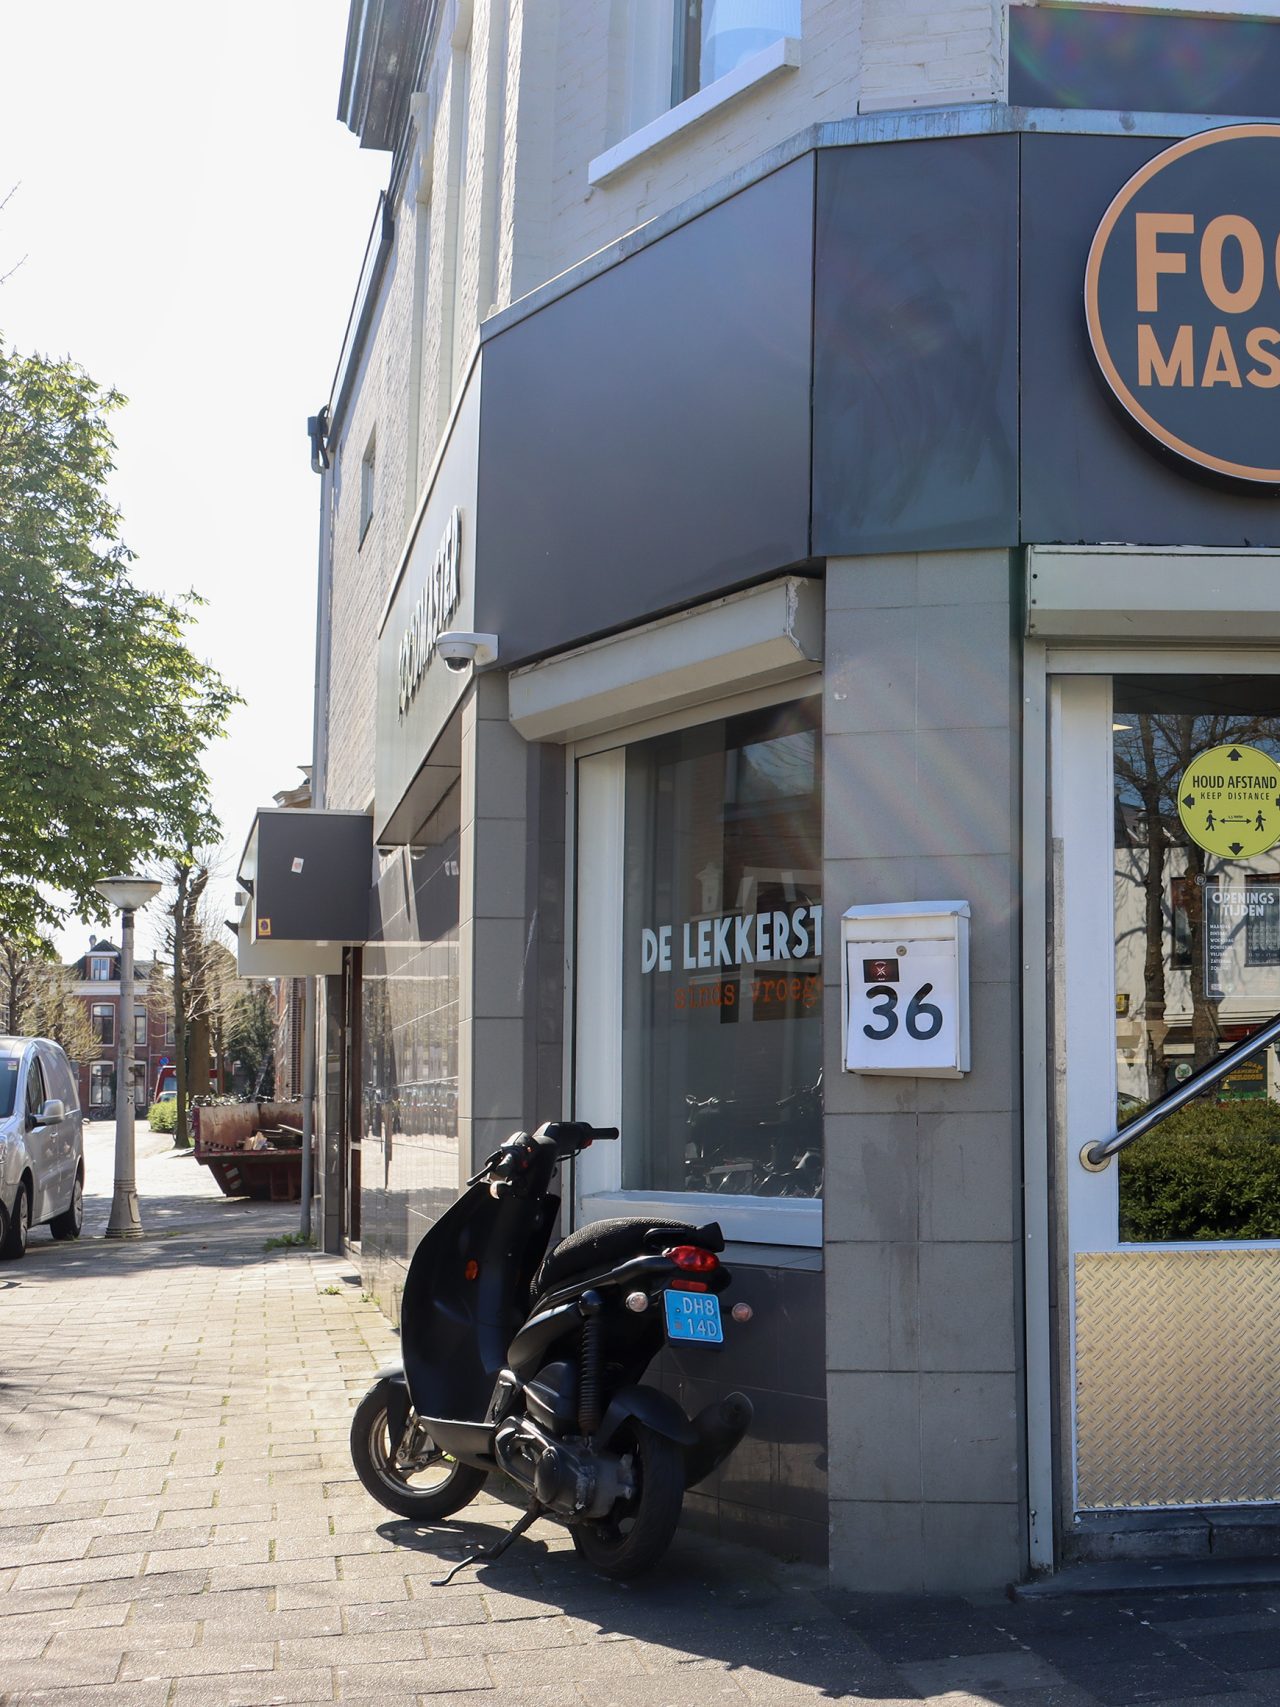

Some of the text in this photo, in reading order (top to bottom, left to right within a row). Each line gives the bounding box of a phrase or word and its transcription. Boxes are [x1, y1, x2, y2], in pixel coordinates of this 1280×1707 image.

[1192, 775, 1277, 789] HOUD AFSTAND
[1200, 791, 1270, 801] KEEP DISTANCE
[1212, 892, 1275, 904] OPENINGS
[1223, 904, 1264, 917] TIJDEN
[641, 924, 672, 974] DE
[674, 978, 737, 1009] sinds
[863, 982, 943, 1041] 36
[682, 1296, 715, 1316] DH8
[687, 1318, 717, 1337] 14D
